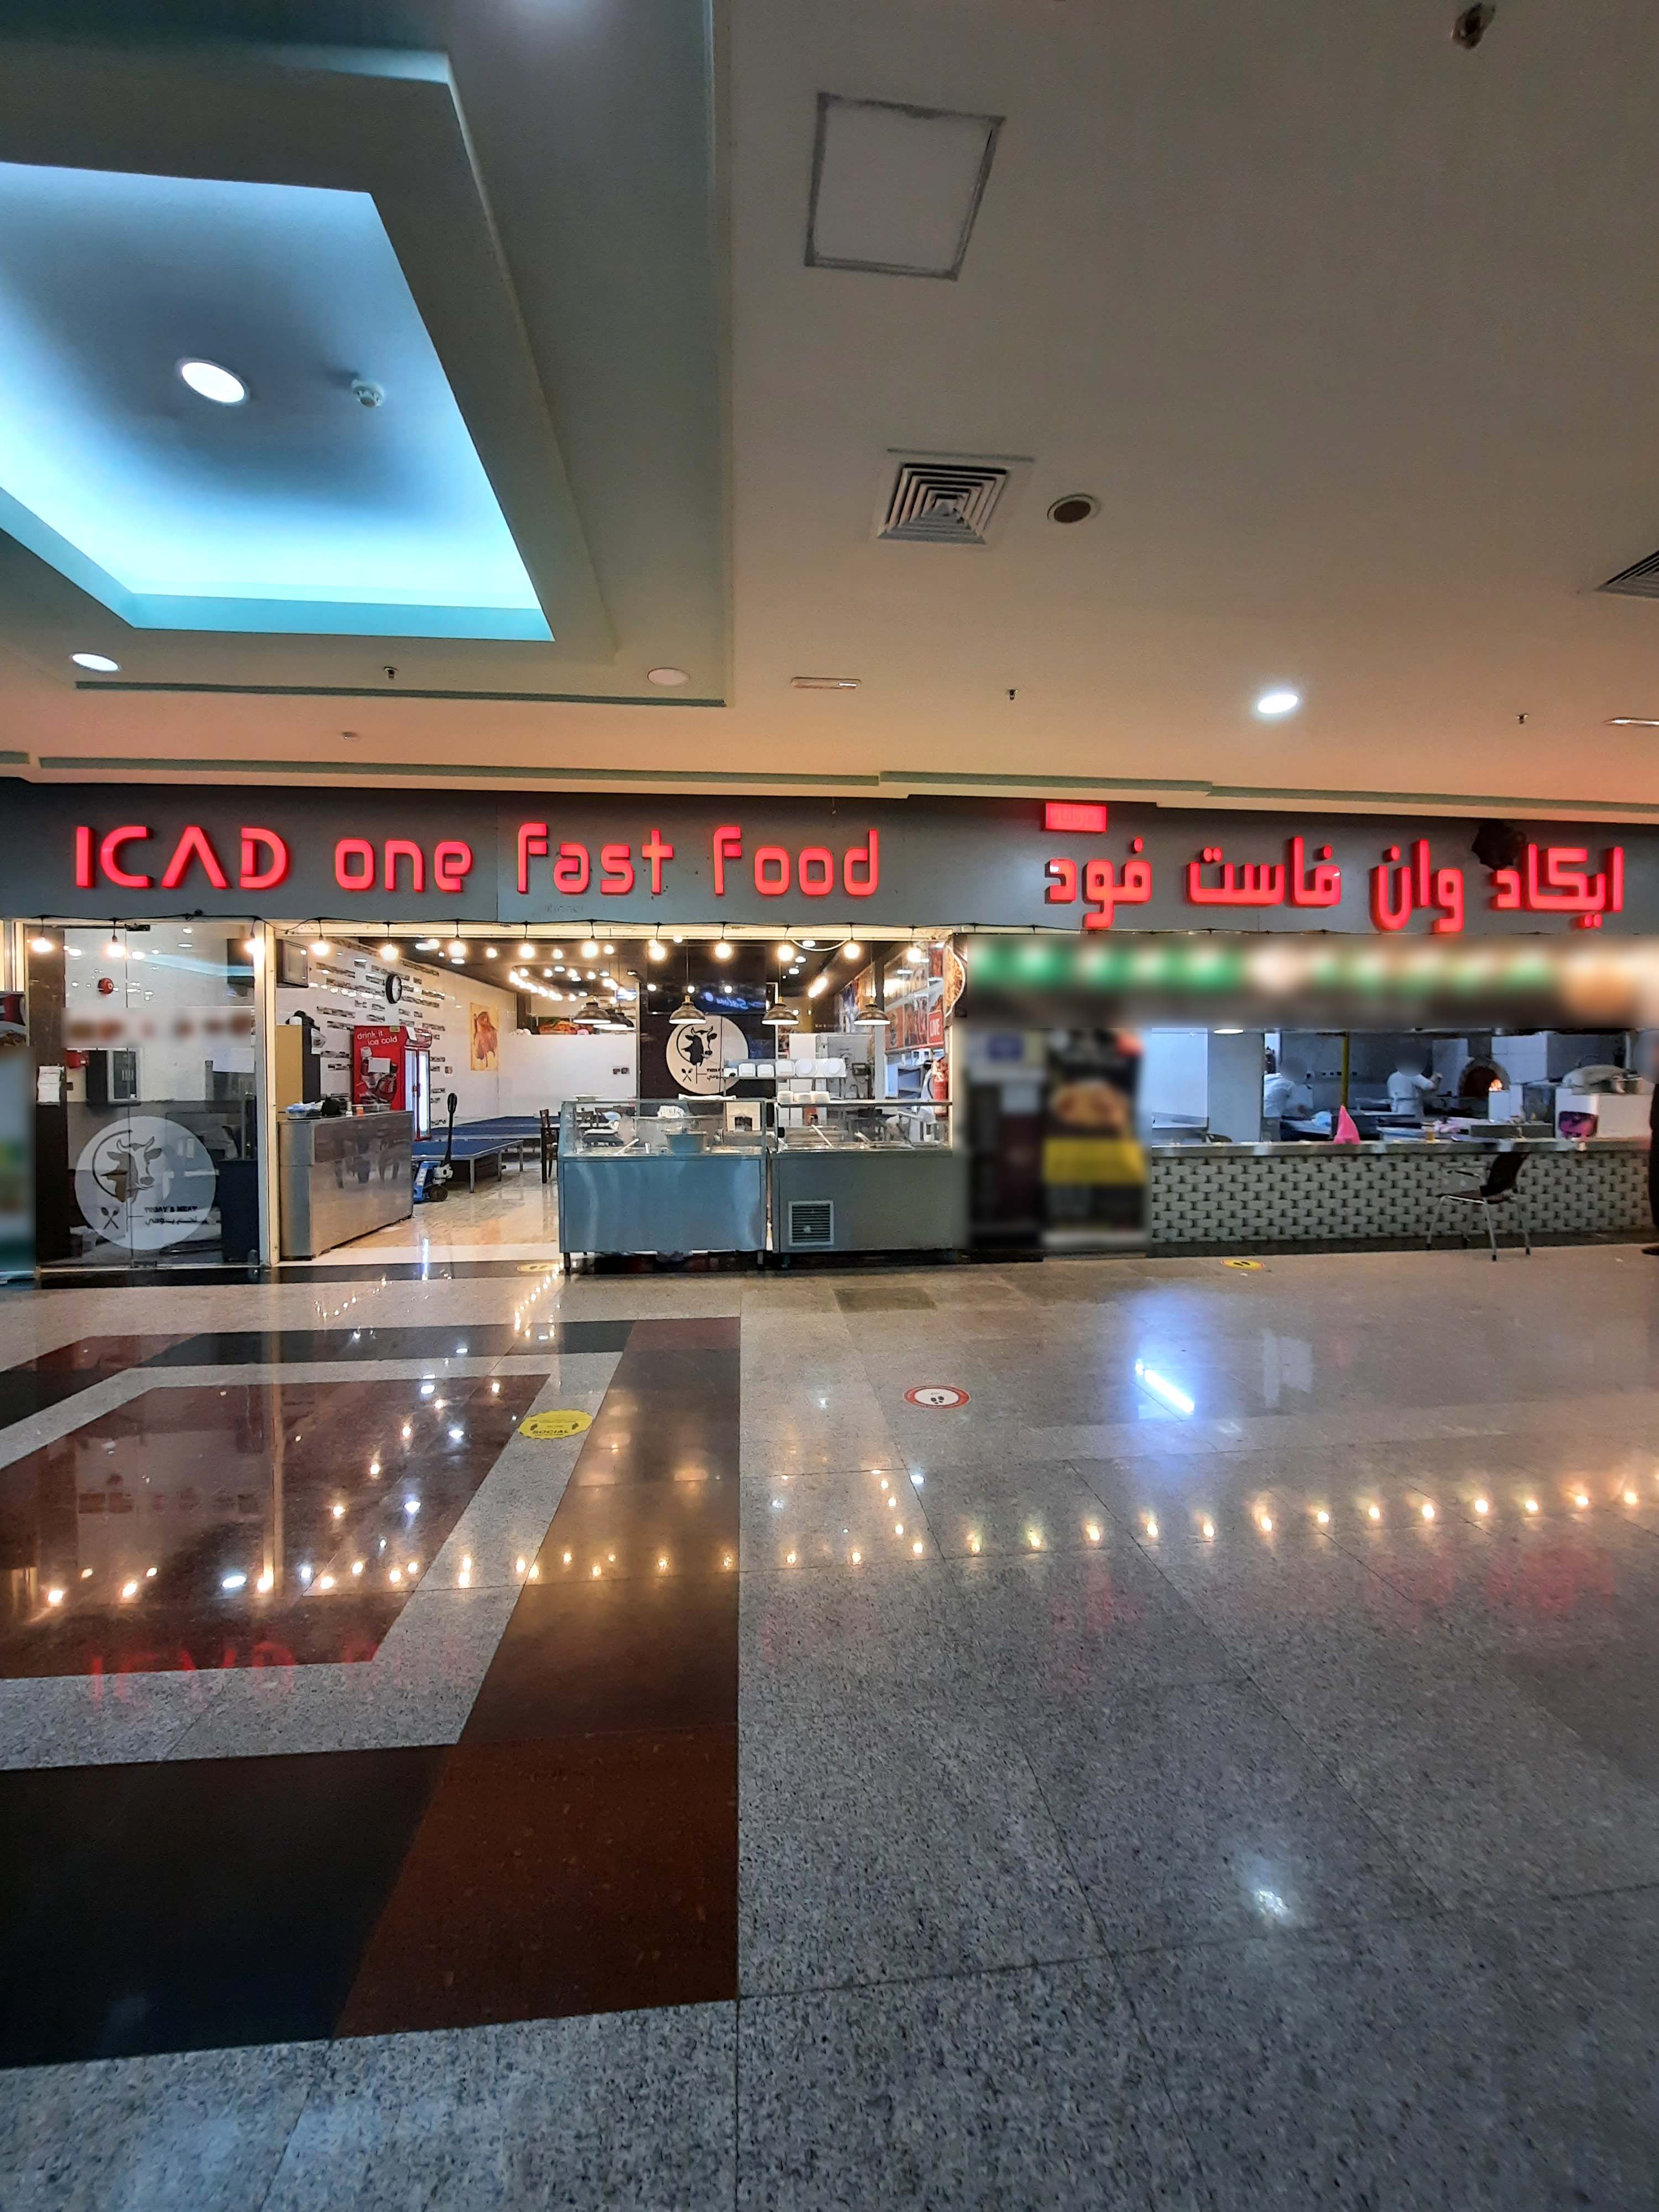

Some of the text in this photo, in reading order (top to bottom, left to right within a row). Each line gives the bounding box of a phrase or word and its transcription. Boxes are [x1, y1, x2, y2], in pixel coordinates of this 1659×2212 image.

[75, 822, 879, 896] ICAD one Fast Food
[1046, 836, 1624, 933] ايكاد وان فاست فود
[357, 1031, 376, 1040] drink
[380, 1035, 398, 1044] cold
